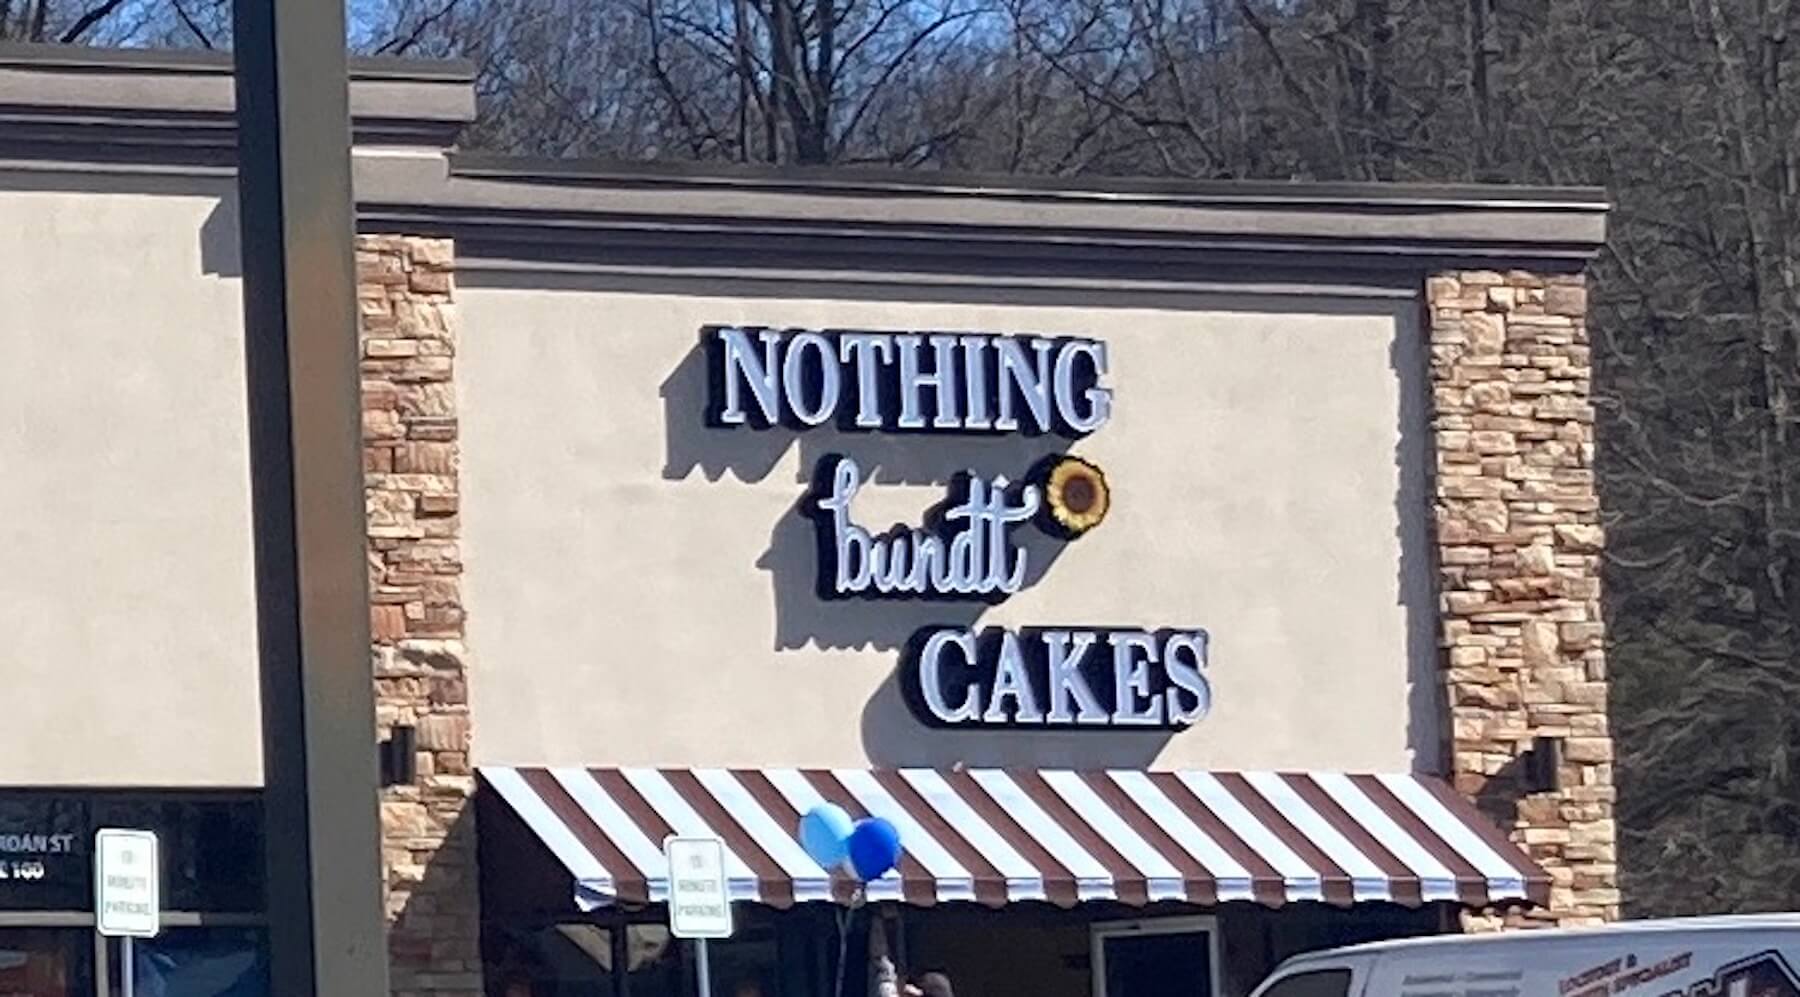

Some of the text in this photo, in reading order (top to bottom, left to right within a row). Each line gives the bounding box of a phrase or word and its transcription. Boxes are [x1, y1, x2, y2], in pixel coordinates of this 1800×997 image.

[718, 328, 1113, 433] NOTHING
[818, 457, 1040, 593] bundt
[919, 628, 1211, 726] CAKES
